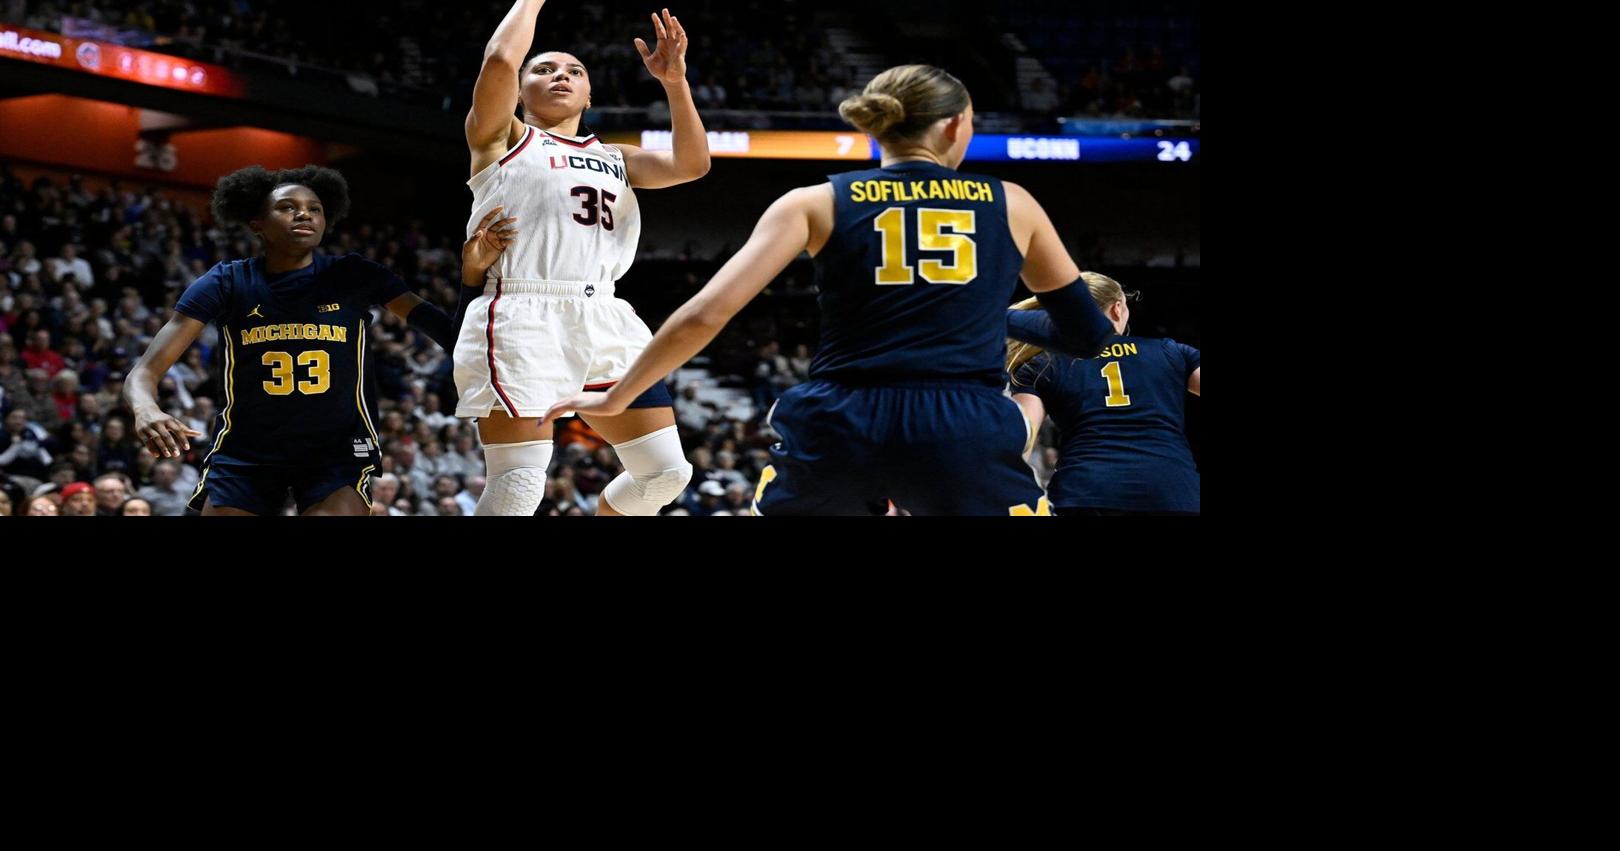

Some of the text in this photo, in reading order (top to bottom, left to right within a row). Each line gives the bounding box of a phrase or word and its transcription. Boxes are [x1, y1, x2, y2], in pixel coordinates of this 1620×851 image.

[834, 136, 855, 155] 7
[1008, 138, 1192, 162] UCONN 24
[549, 155, 629, 187] UCONN
[850, 179, 994, 203] SOFILKANICH
[570, 186, 617, 232] 35
[873, 207, 977, 286] 15
[241, 323, 347, 346] MICHIGAN
[1095, 343, 1138, 358] SON
[261, 349, 331, 396] 33
[1100, 361, 1131, 407] 1
